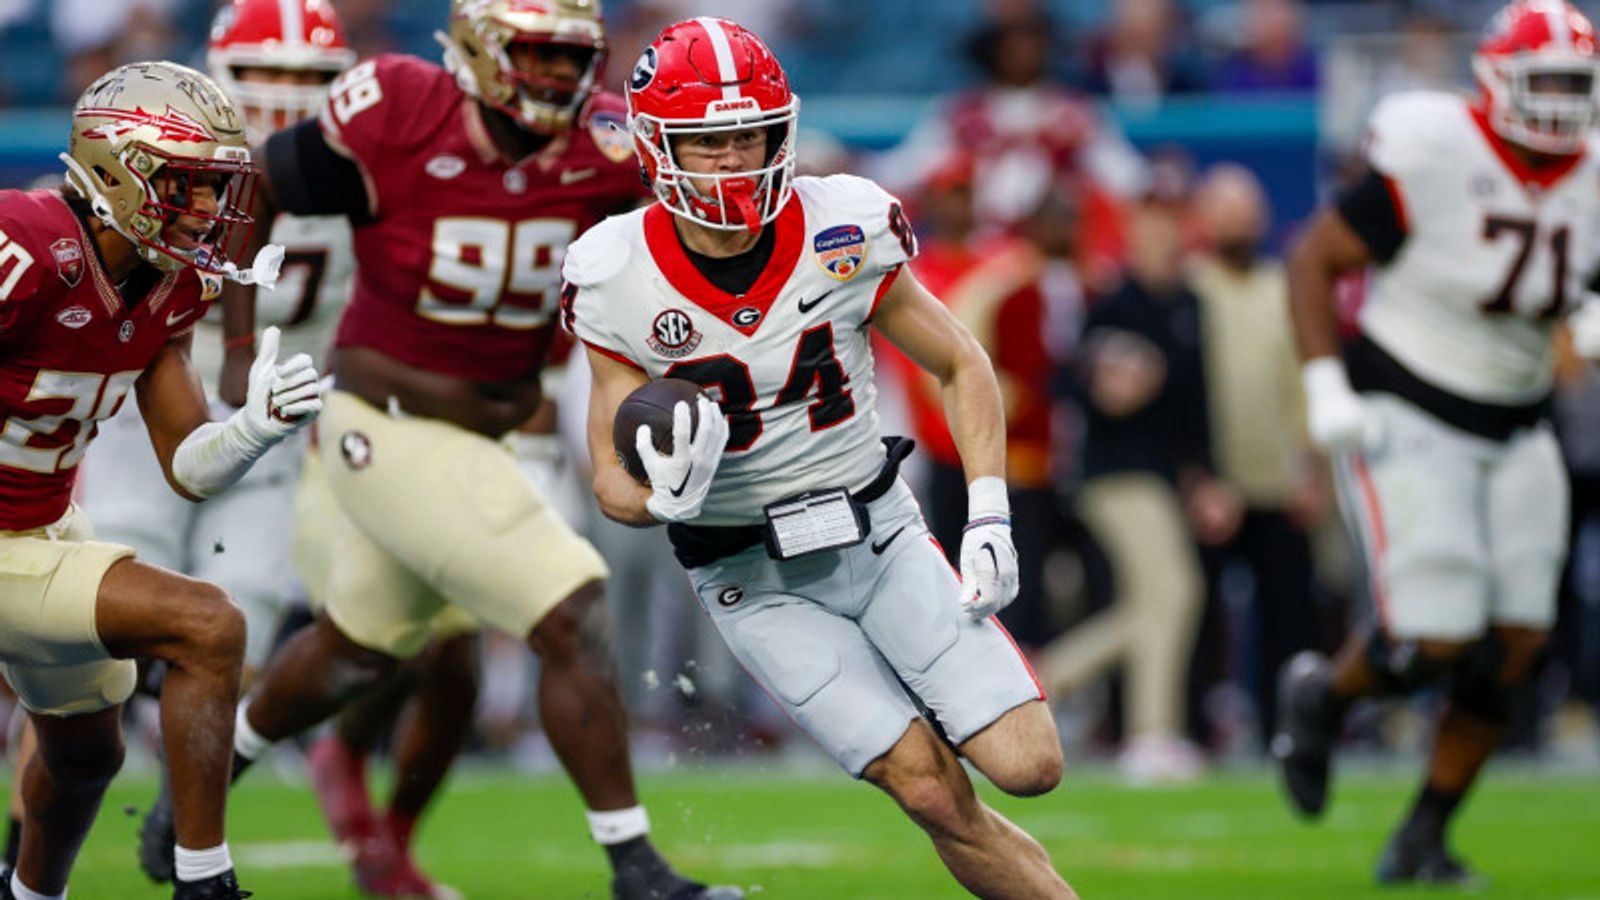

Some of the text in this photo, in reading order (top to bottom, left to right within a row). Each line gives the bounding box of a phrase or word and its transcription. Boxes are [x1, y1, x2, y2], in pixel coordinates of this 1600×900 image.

[714, 100, 753, 112] DAWGS
[415, 215, 577, 330] 99
[1481, 213, 1570, 318] 71
[655, 311, 690, 346] SEC
[735, 309, 760, 324] G
[720, 587, 742, 605] G
